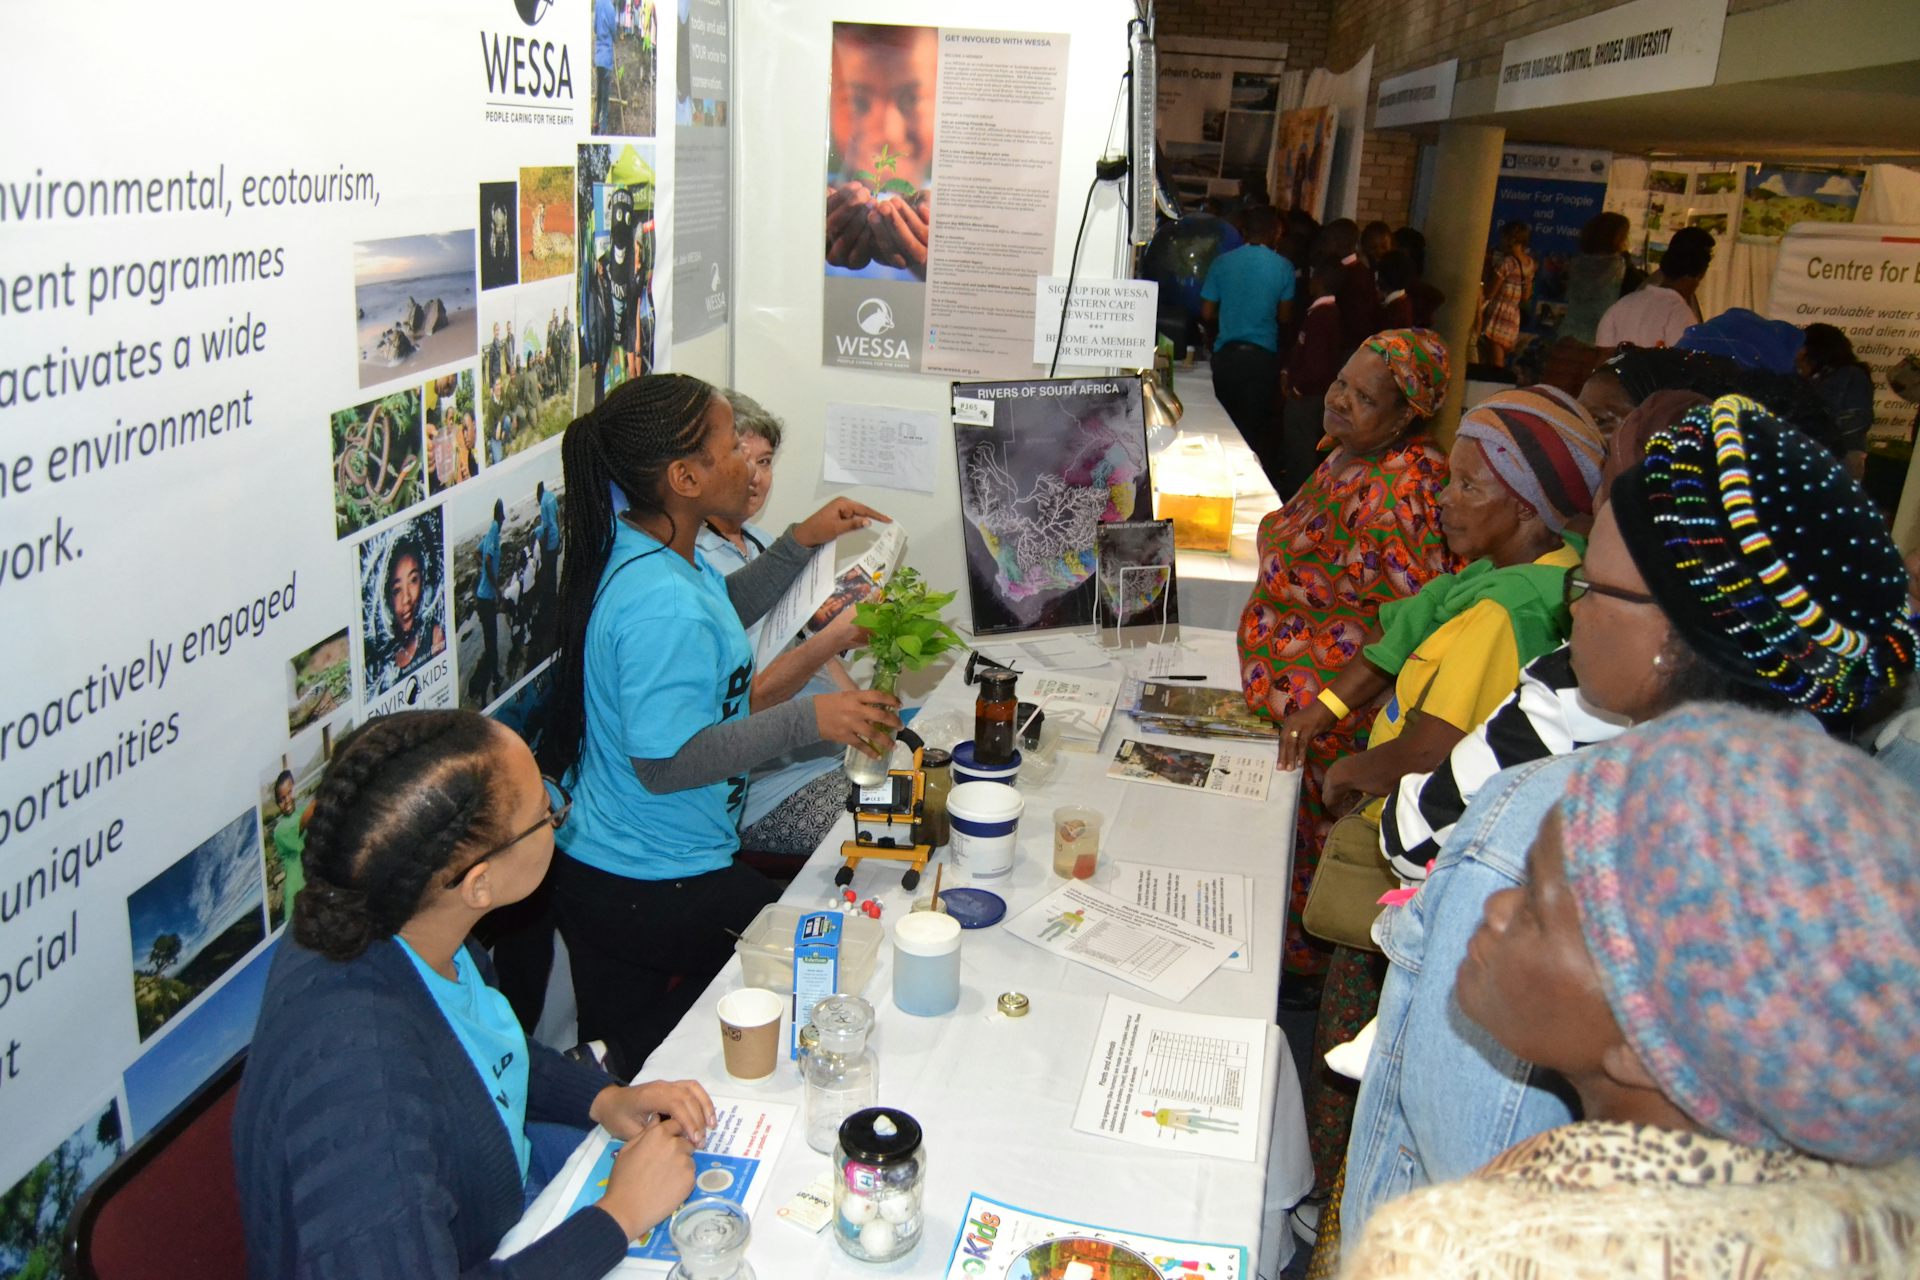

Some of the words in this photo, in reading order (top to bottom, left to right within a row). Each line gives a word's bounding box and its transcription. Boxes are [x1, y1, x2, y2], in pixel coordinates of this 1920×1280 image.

[962, 36, 1000, 44] INVOLVED
[1003, 37, 1022, 45] WITH
[1024, 38, 1051, 47] WESSA
[1503, 63, 1521, 84] CENTRE
[1521, 60, 1531, 80] FOR
[1531, 53, 1562, 79] BIOLOGICAL
[1594, 38, 1623, 66] RHODES
[1624, 27, 1673, 61] UNIVERSITY
[481, 31, 573, 99] WESSA
[1192, 68, 1222, 79] Ocean
[486, 111, 509, 123] PEOPLE
[511, 112, 532, 124] CARING
[534, 113, 544, 124] FOR
[546, 114, 556, 125] THE
[557, 115, 573, 126] EARTH
[242, 164, 380, 207] ecotourism,
[1501, 189, 1532, 200] Water
[1535, 191, 1552, 202] For
[1556, 193, 1593, 207] People
[1535, 209, 1554, 219] and
[1536, 223, 1554, 233] For
[1807, 257, 1873, 281] Centre
[1880, 260, 1909, 283] for
[89, 247, 284, 315] programmes
[1075, 287, 1088, 295] UP
[1091, 287, 1110, 296] FOR
[1114, 288, 1149, 298] WESSA
[705, 293, 726, 312] WESSA
[1109, 300, 1135, 310] CAPE
[1797, 303, 1820, 315] Our
[1822, 304, 1874, 318] valuable
[1878, 308, 1913, 320] water
[1850, 325, 1873, 336] and
[1876, 326, 1906, 337] alien
[836, 335, 911, 359] WESSA
[1091, 335, 1098, 345] A
[1100, 336, 1146, 347] MEMBER
[1074, 346, 1133, 359] SUPPORTER
[1857, 344, 1894, 357] ability
[1897, 345, 1910, 356] to
[0, 340, 162, 408] activates
[174, 335, 191, 369] a
[202, 312, 267, 363] wide
[978, 388, 1018, 399] RIVERS
[1022, 387, 1036, 398] OF
[1039, 385, 1077, 397] SOUTH
[1080, 383, 1119, 395] AFRICA
[48, 390, 253, 483] environment
[0, 517, 83, 586] ork.
[1, 639, 173, 761] roactively
[182, 570, 296, 664] engaged
[1, 819, 124, 923] unique
[1098, 1072, 1108, 1086] Plants
[1106, 1041, 1116, 1060] Animals
